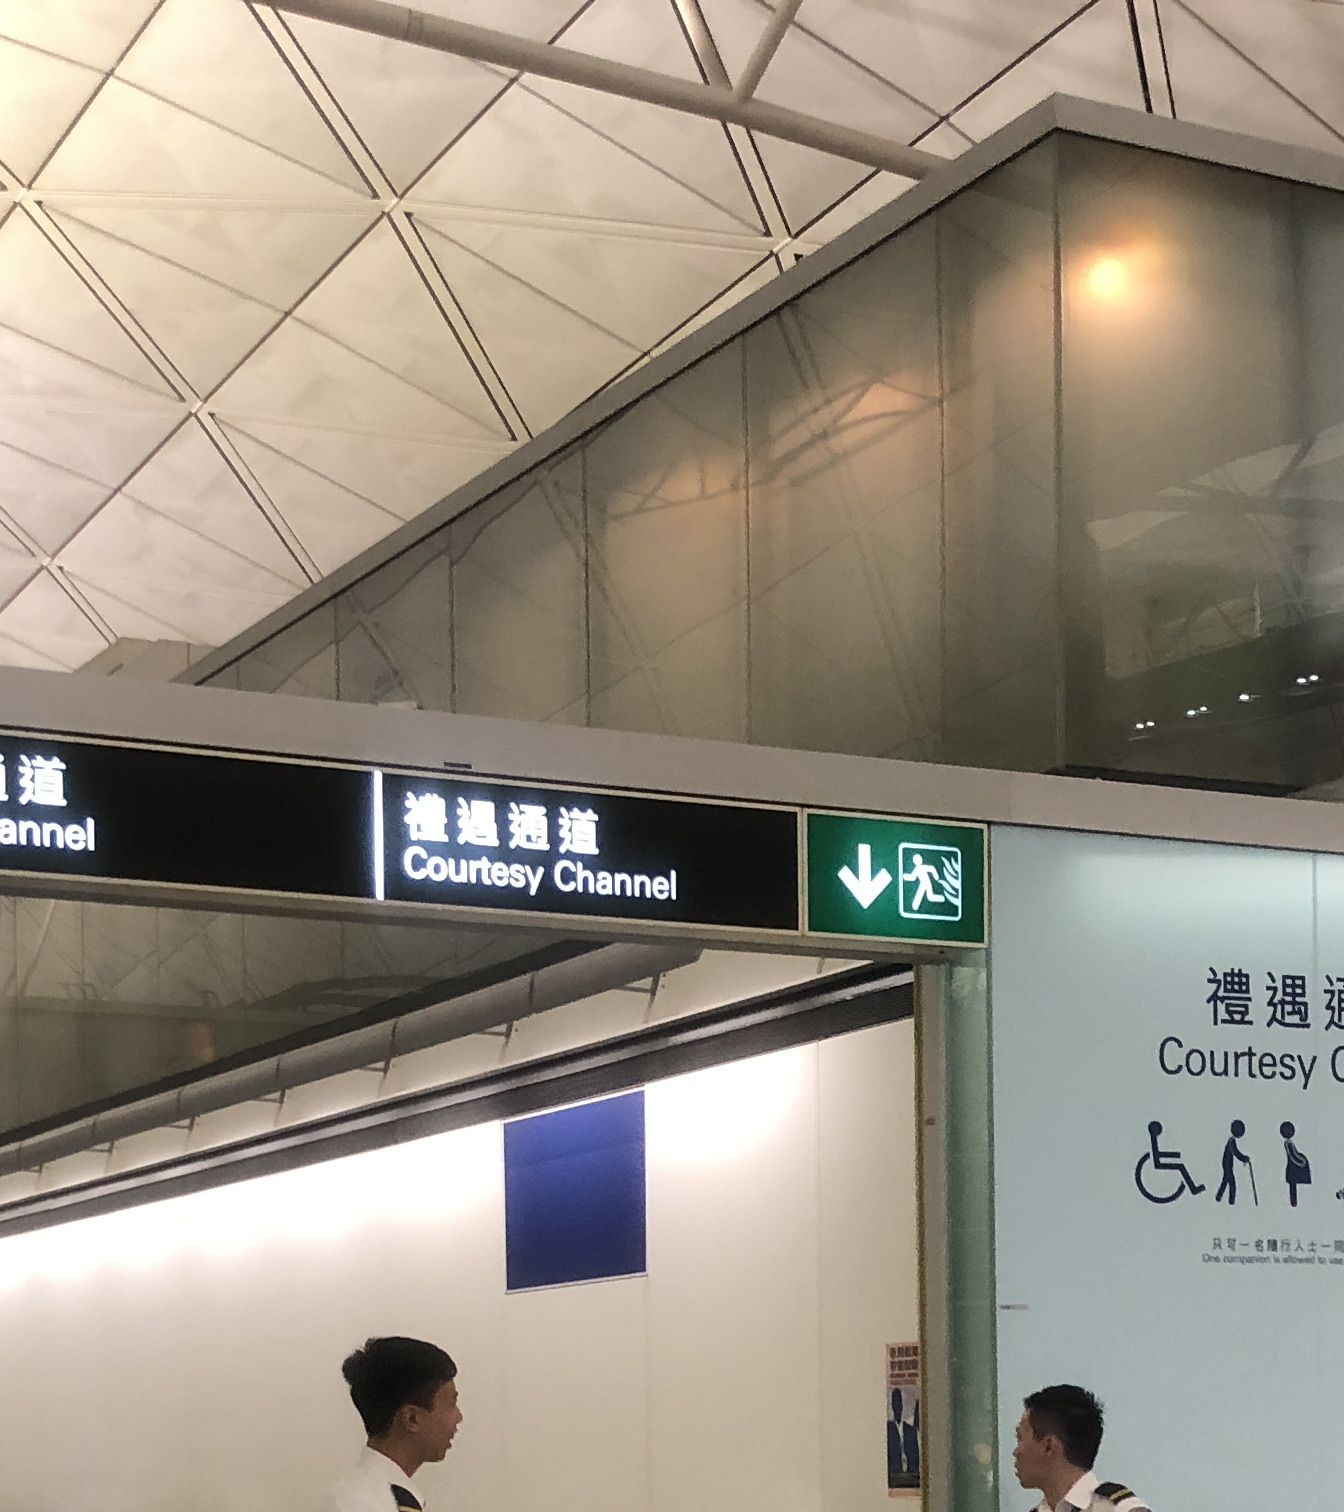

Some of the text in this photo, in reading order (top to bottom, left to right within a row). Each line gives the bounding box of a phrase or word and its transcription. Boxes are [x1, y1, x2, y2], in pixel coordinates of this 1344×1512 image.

[403, 790, 600, 855] 禮遇通道
[403, 846, 677, 900] Courtesy Channel
[1158, 1036, 1318, 1090] Courtesy
